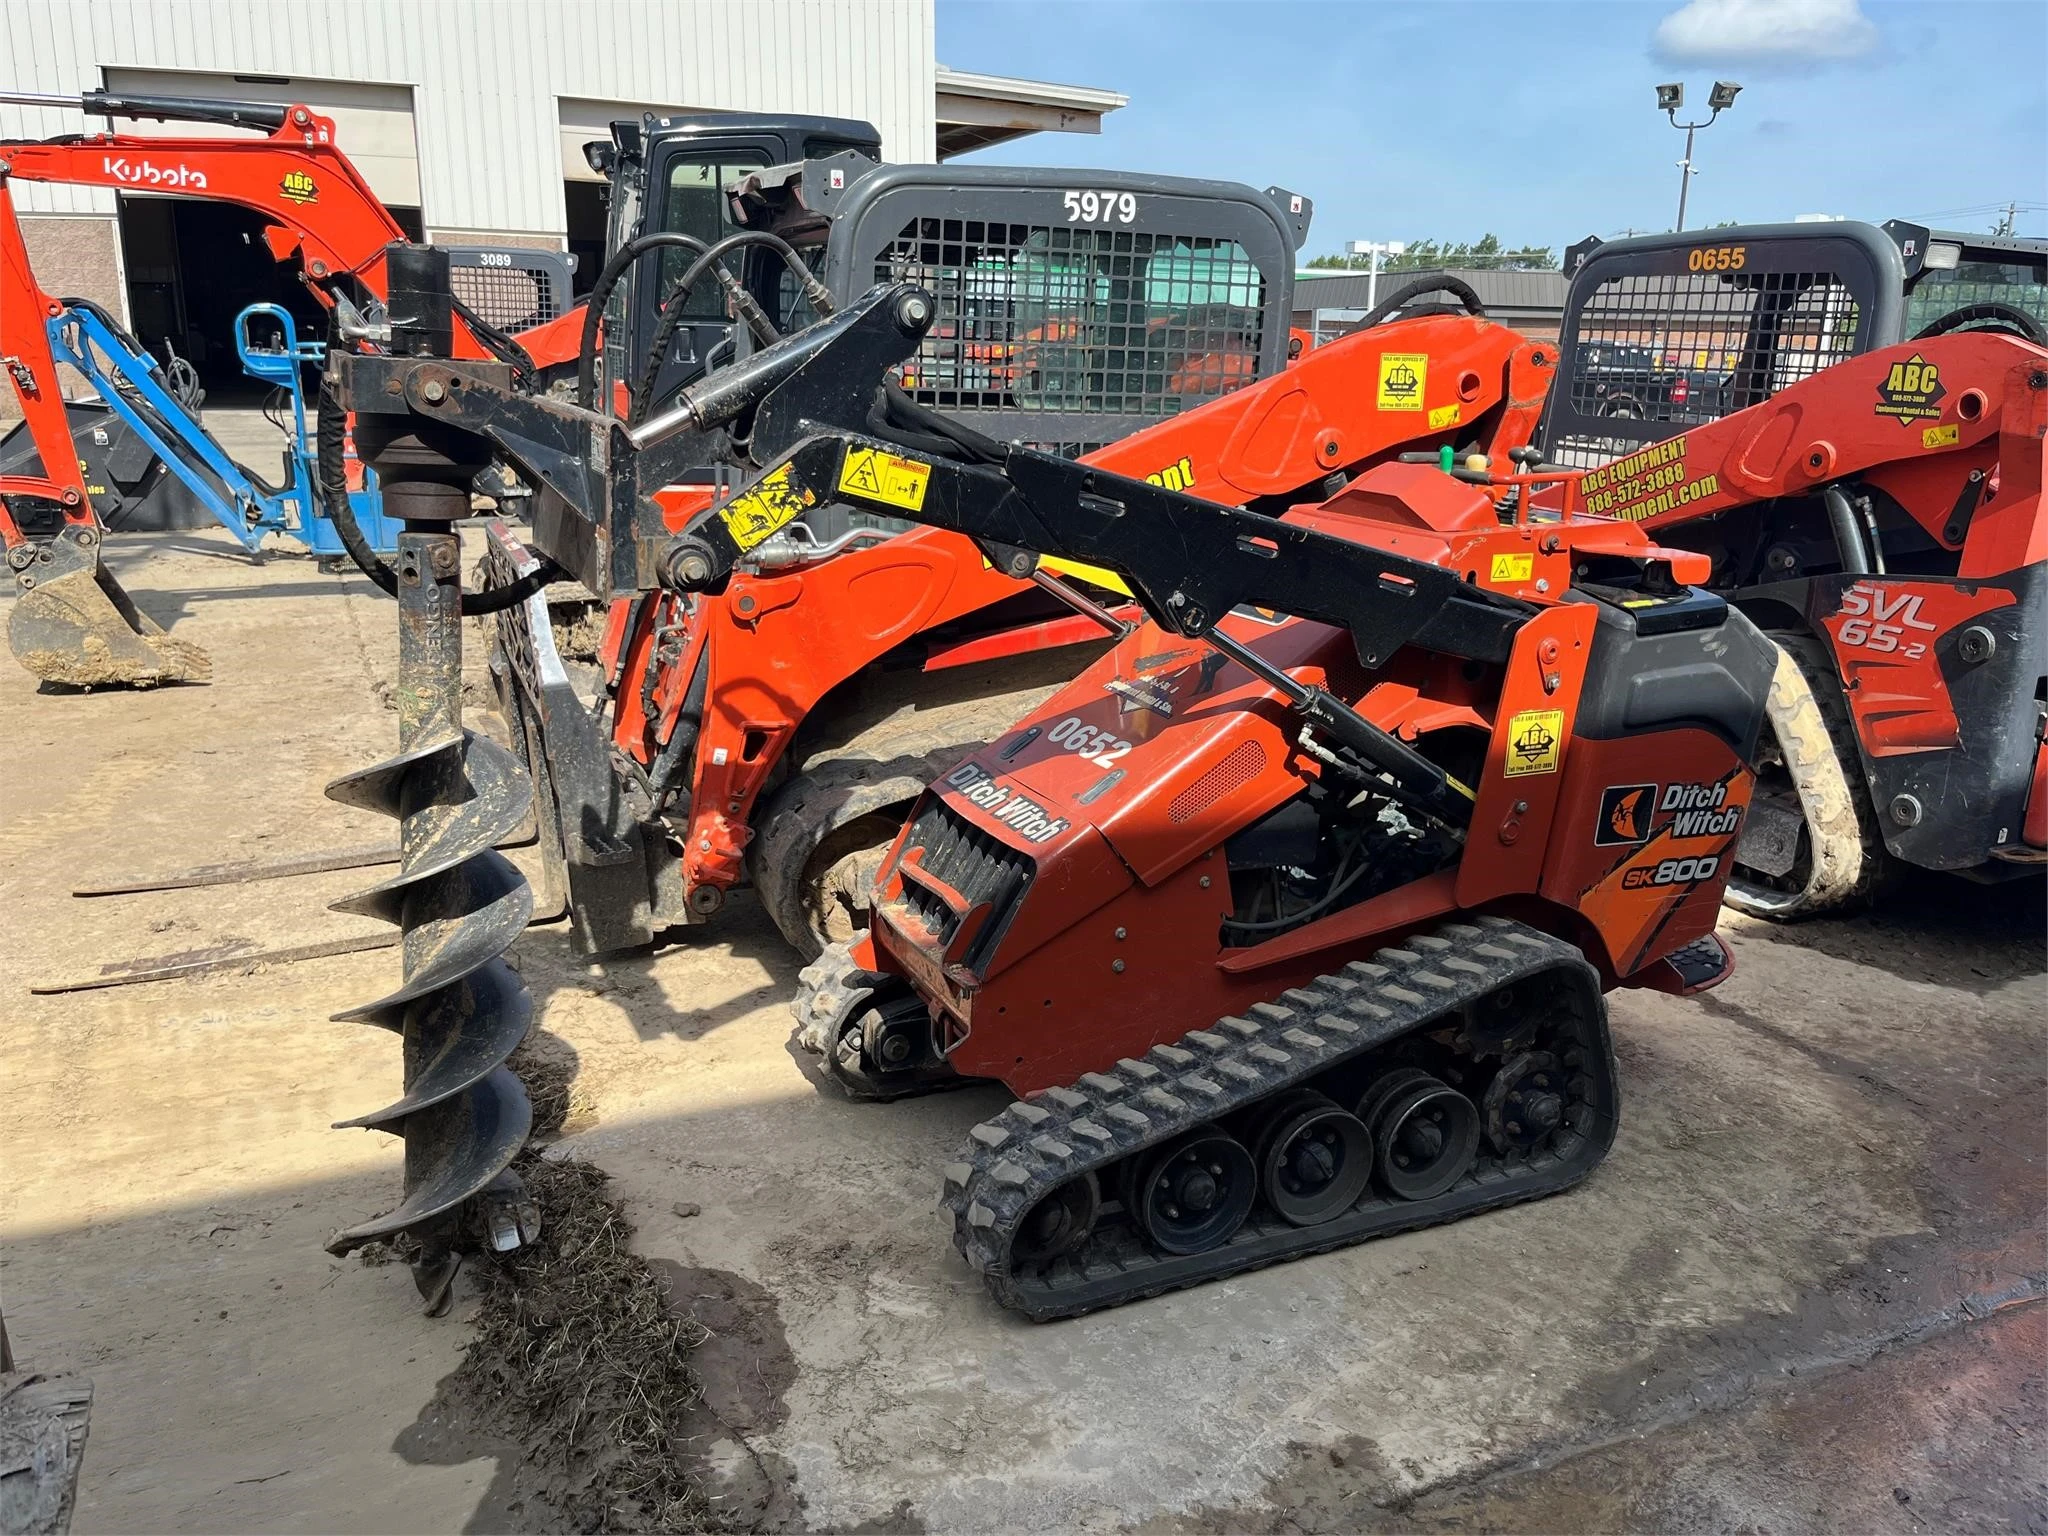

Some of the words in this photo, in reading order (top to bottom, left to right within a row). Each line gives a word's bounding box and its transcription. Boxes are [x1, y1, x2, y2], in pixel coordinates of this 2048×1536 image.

[104, 157, 207, 189] Kubota
[285, 173, 313, 191] ABC
[1064, 189, 1136, 223] 5979
[480, 253, 512, 266] 3089
[1689, 248, 1745, 271] 0655
[1389, 369, 1413, 384] ABC
[1887, 364, 1938, 394] ABC
[1581, 470, 1607, 496] ABC
[1609, 436, 1687, 484] EQUIPMENT
[1586, 462, 1686, 515] 888-572-3888
[1838, 584, 1936, 631] SVL
[1838, 618, 1927, 660] 65-2
[1048, 717, 1132, 770] 0652
[1519, 729, 1549, 746] ABC
[950, 763, 1010, 810] Ditch
[991, 796, 1061, 843] Witch
[1661, 782, 1726, 810] Ditch
[1673, 808, 1740, 837] Witch
[1624, 857, 1719, 886] SK800
